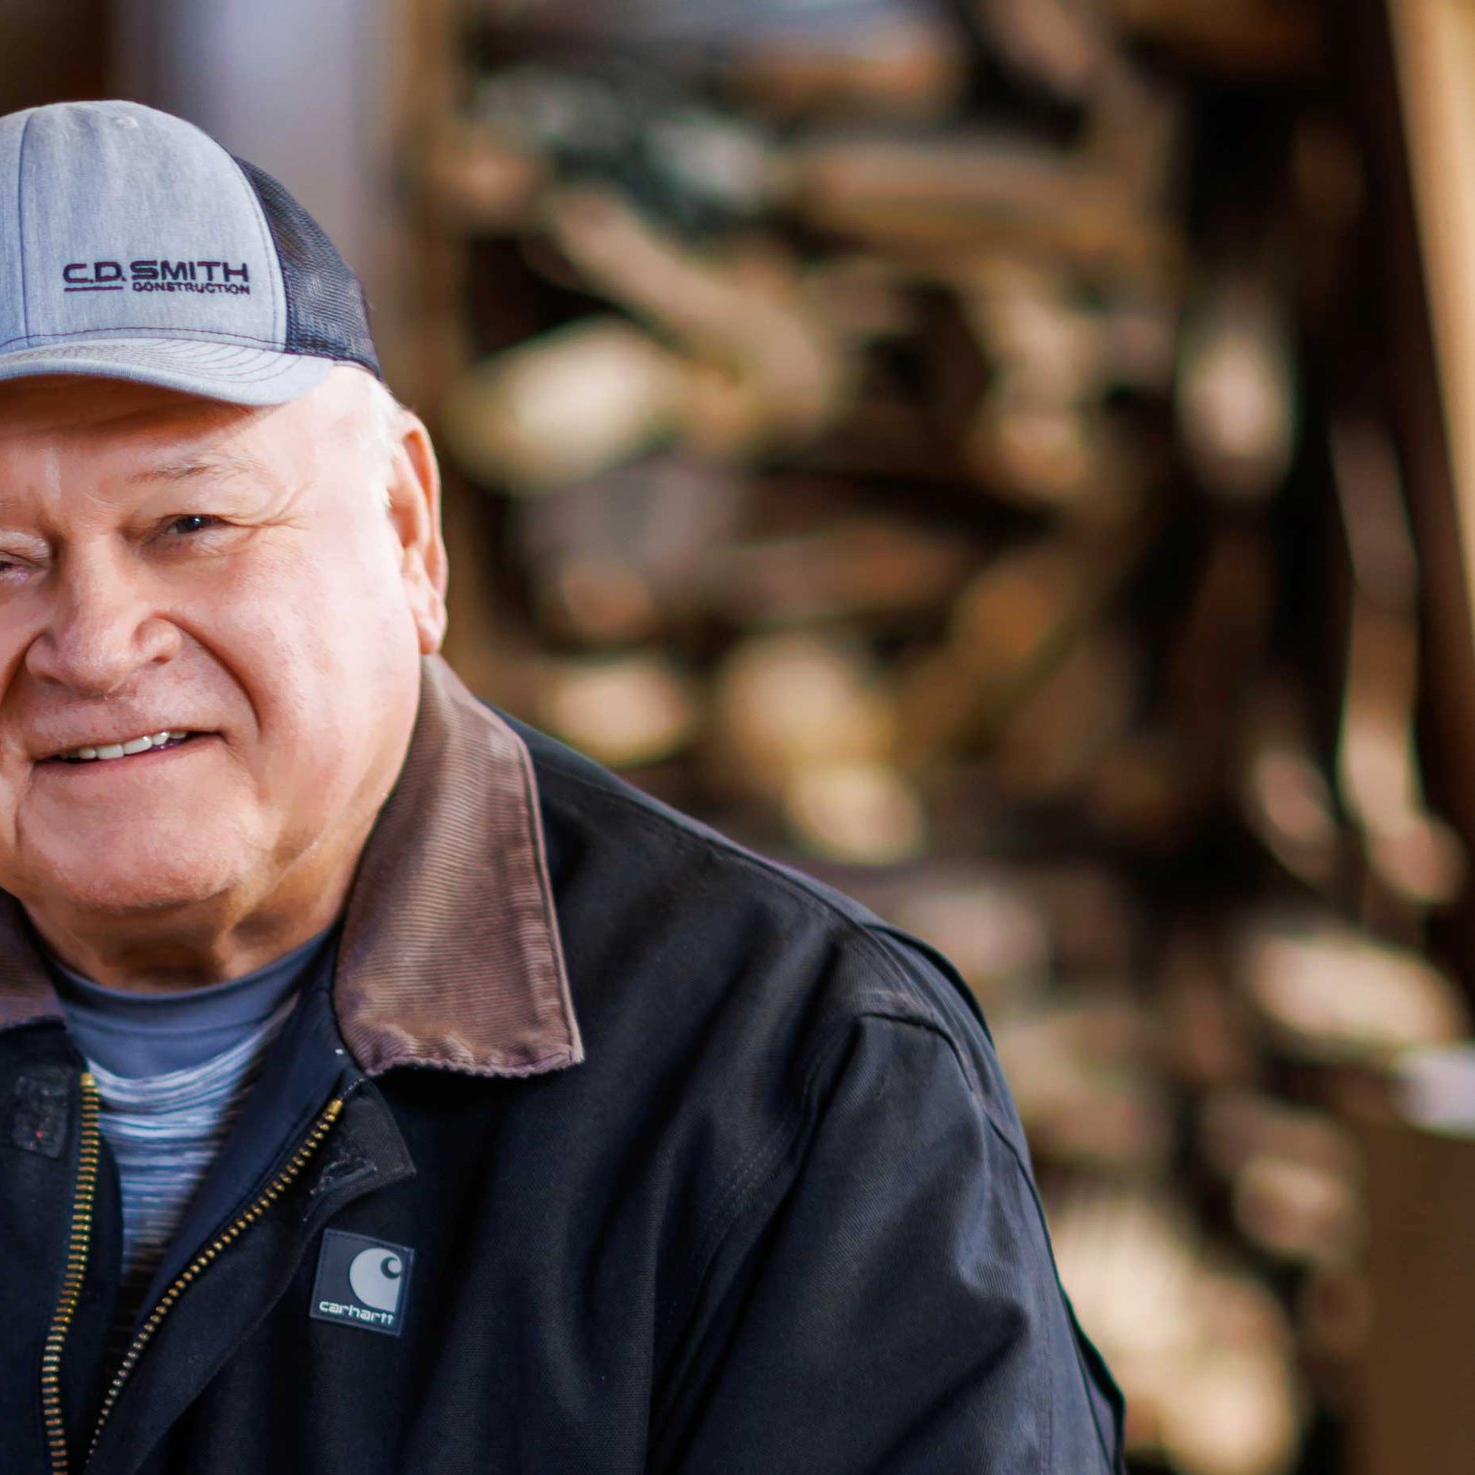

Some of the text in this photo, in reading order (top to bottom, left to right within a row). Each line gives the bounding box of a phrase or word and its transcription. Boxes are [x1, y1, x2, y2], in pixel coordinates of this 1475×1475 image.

[62, 259, 250, 284] C.D. SMITH
[132, 281, 251, 295] CONSTRUCTION
[318, 1300, 394, 1325] carhartt
